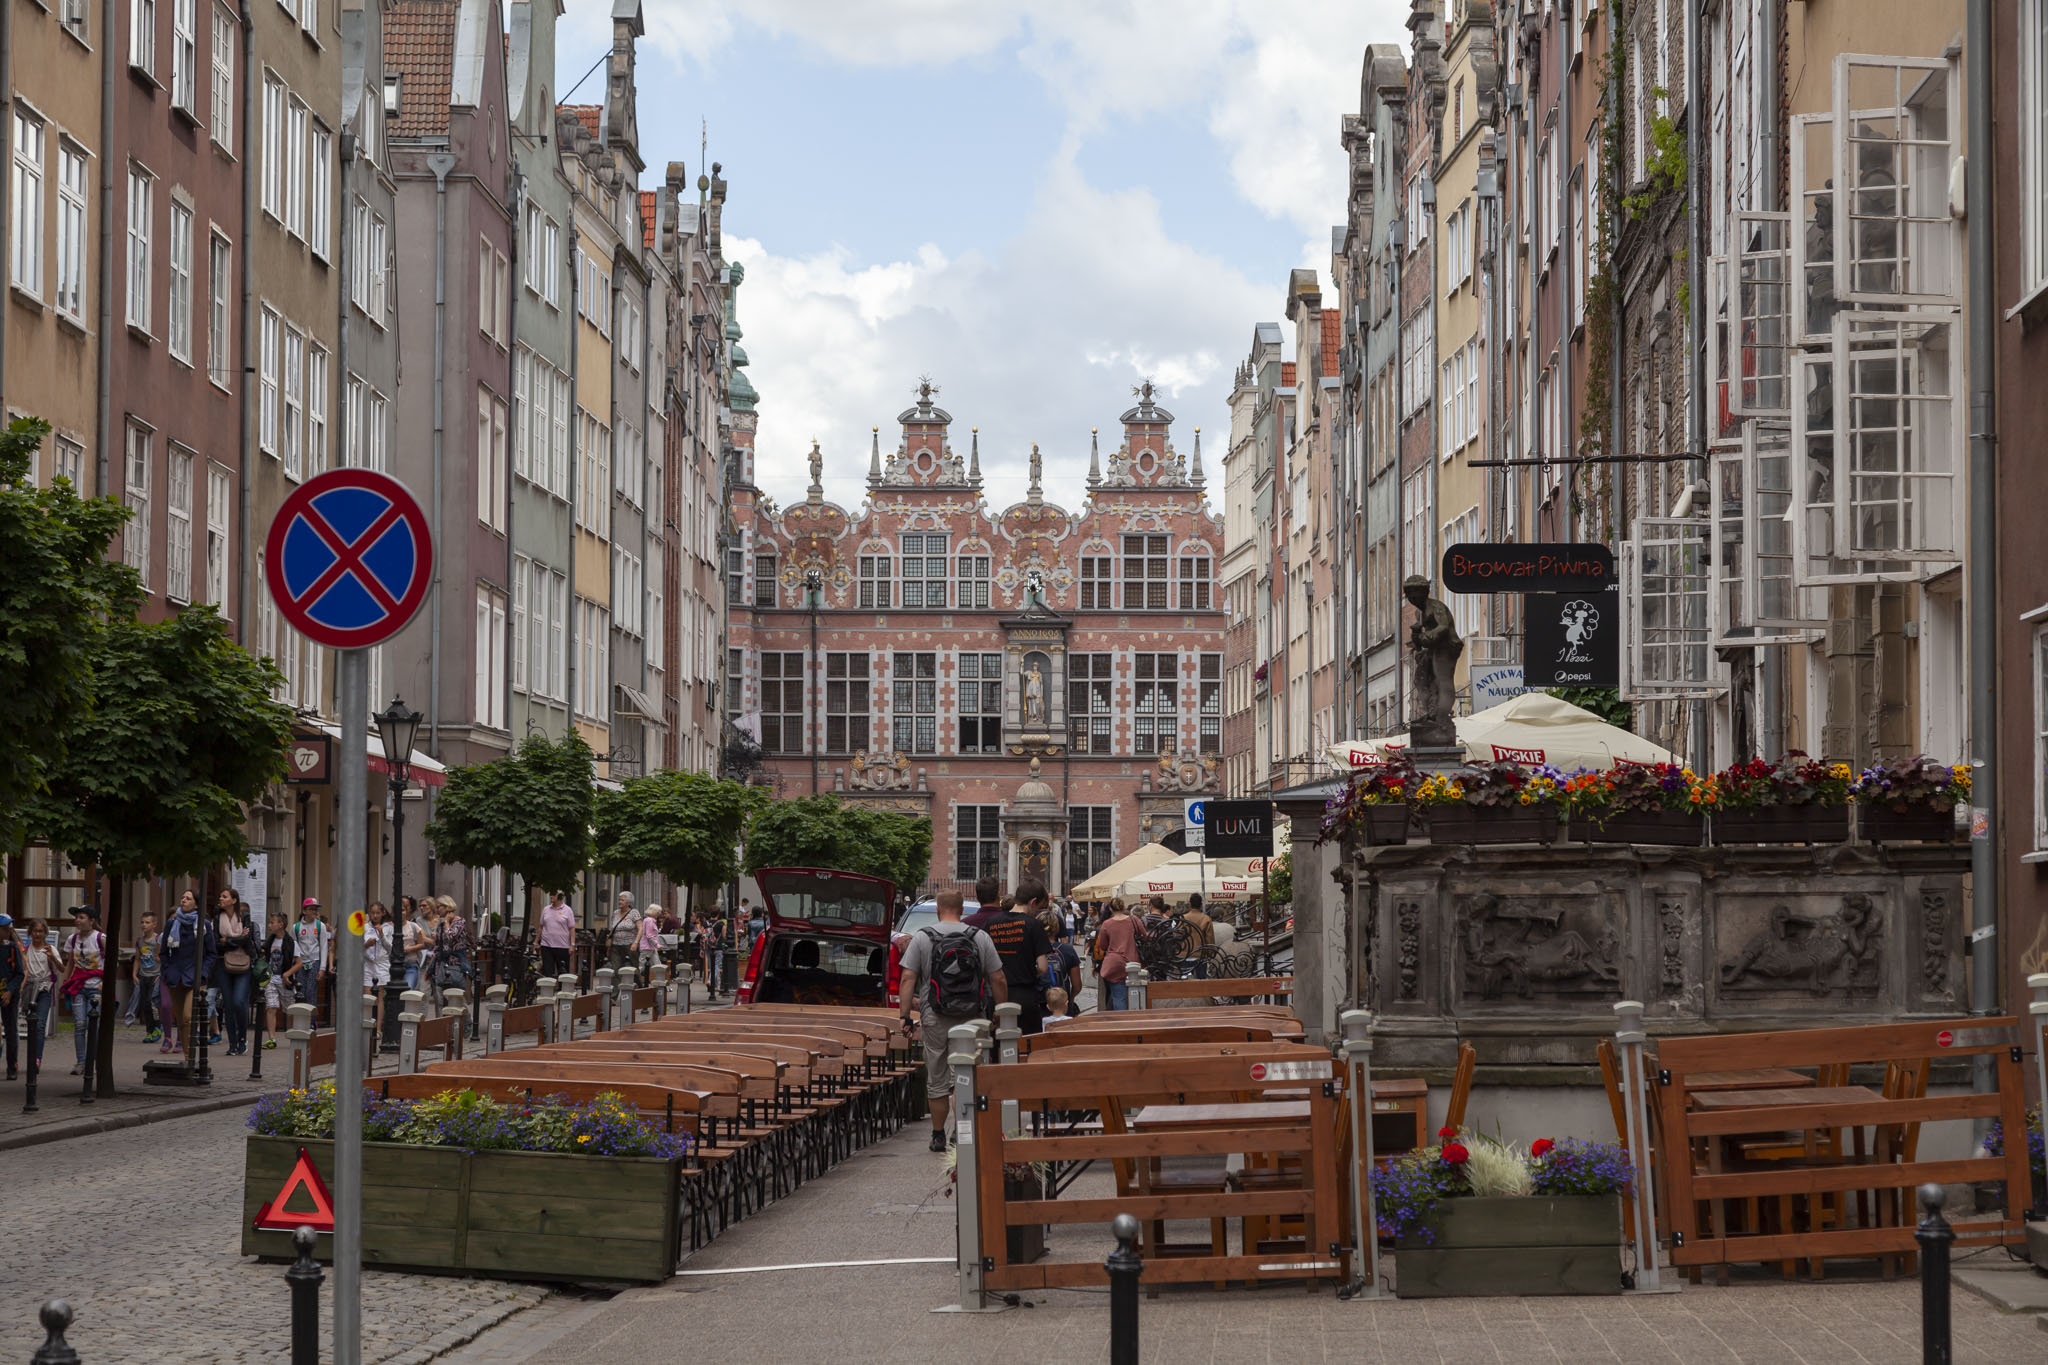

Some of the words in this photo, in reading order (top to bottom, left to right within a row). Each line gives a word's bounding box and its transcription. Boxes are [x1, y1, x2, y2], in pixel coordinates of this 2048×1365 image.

[1538, 555, 1603, 577] Piwna
[1475, 669, 1523, 692] ANTYKWA
[1568, 672, 1591, 682] pepsi
[1352, 752, 1383, 765] TYSK
[1494, 747, 1543, 764] TYSKIE
[1216, 818, 1261, 835] LUMI
[1150, 883, 1172, 891] TYSKIE
[1223, 882, 1246, 890] TYSKIE
